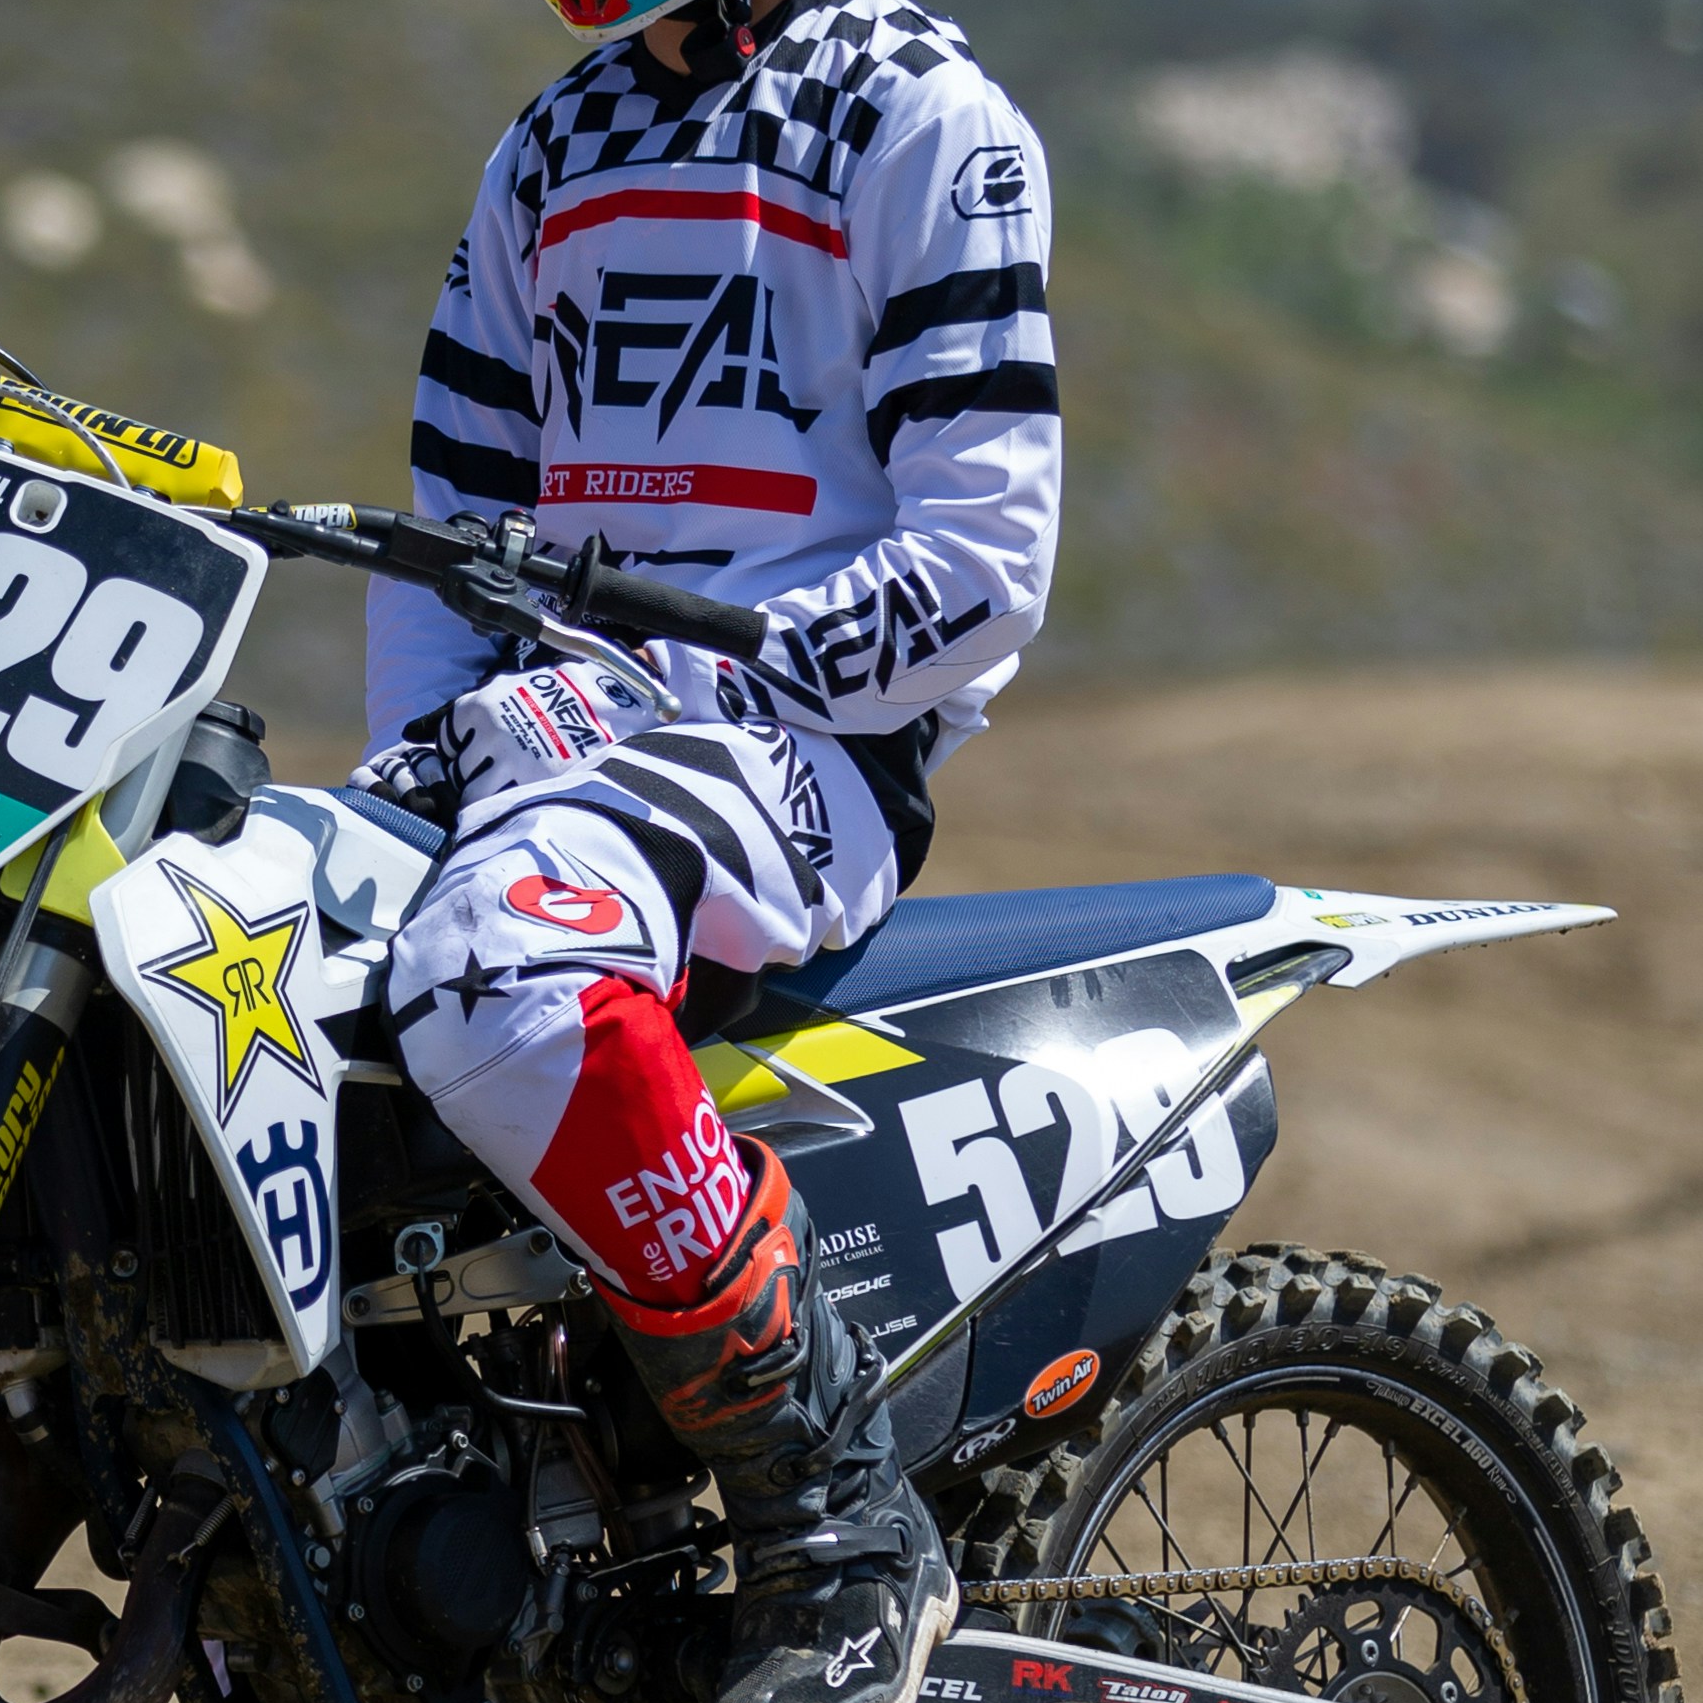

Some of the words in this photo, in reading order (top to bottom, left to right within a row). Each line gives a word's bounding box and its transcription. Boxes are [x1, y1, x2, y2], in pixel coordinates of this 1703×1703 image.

[583, 469, 695, 498] RIDERS
[898, 1028, 1246, 1302] 529
[654, 1126, 751, 1274] RIDE
[819, 1222, 882, 1258] ADISE
[843, 1244, 885, 1263] CADILLAC
[642, 1240, 674, 1283] the
[869, 1313, 918, 1340] LUSE
[1031, 1378, 1071, 1415] Twin
[1071, 1354, 1095, 1383] Air
[1409, 1399, 1461, 1444] EXCEL
[1461, 1438, 1492, 1471] A60
[916, 1675, 983, 1703] CEL
[1011, 1658, 1075, 1695] RK
